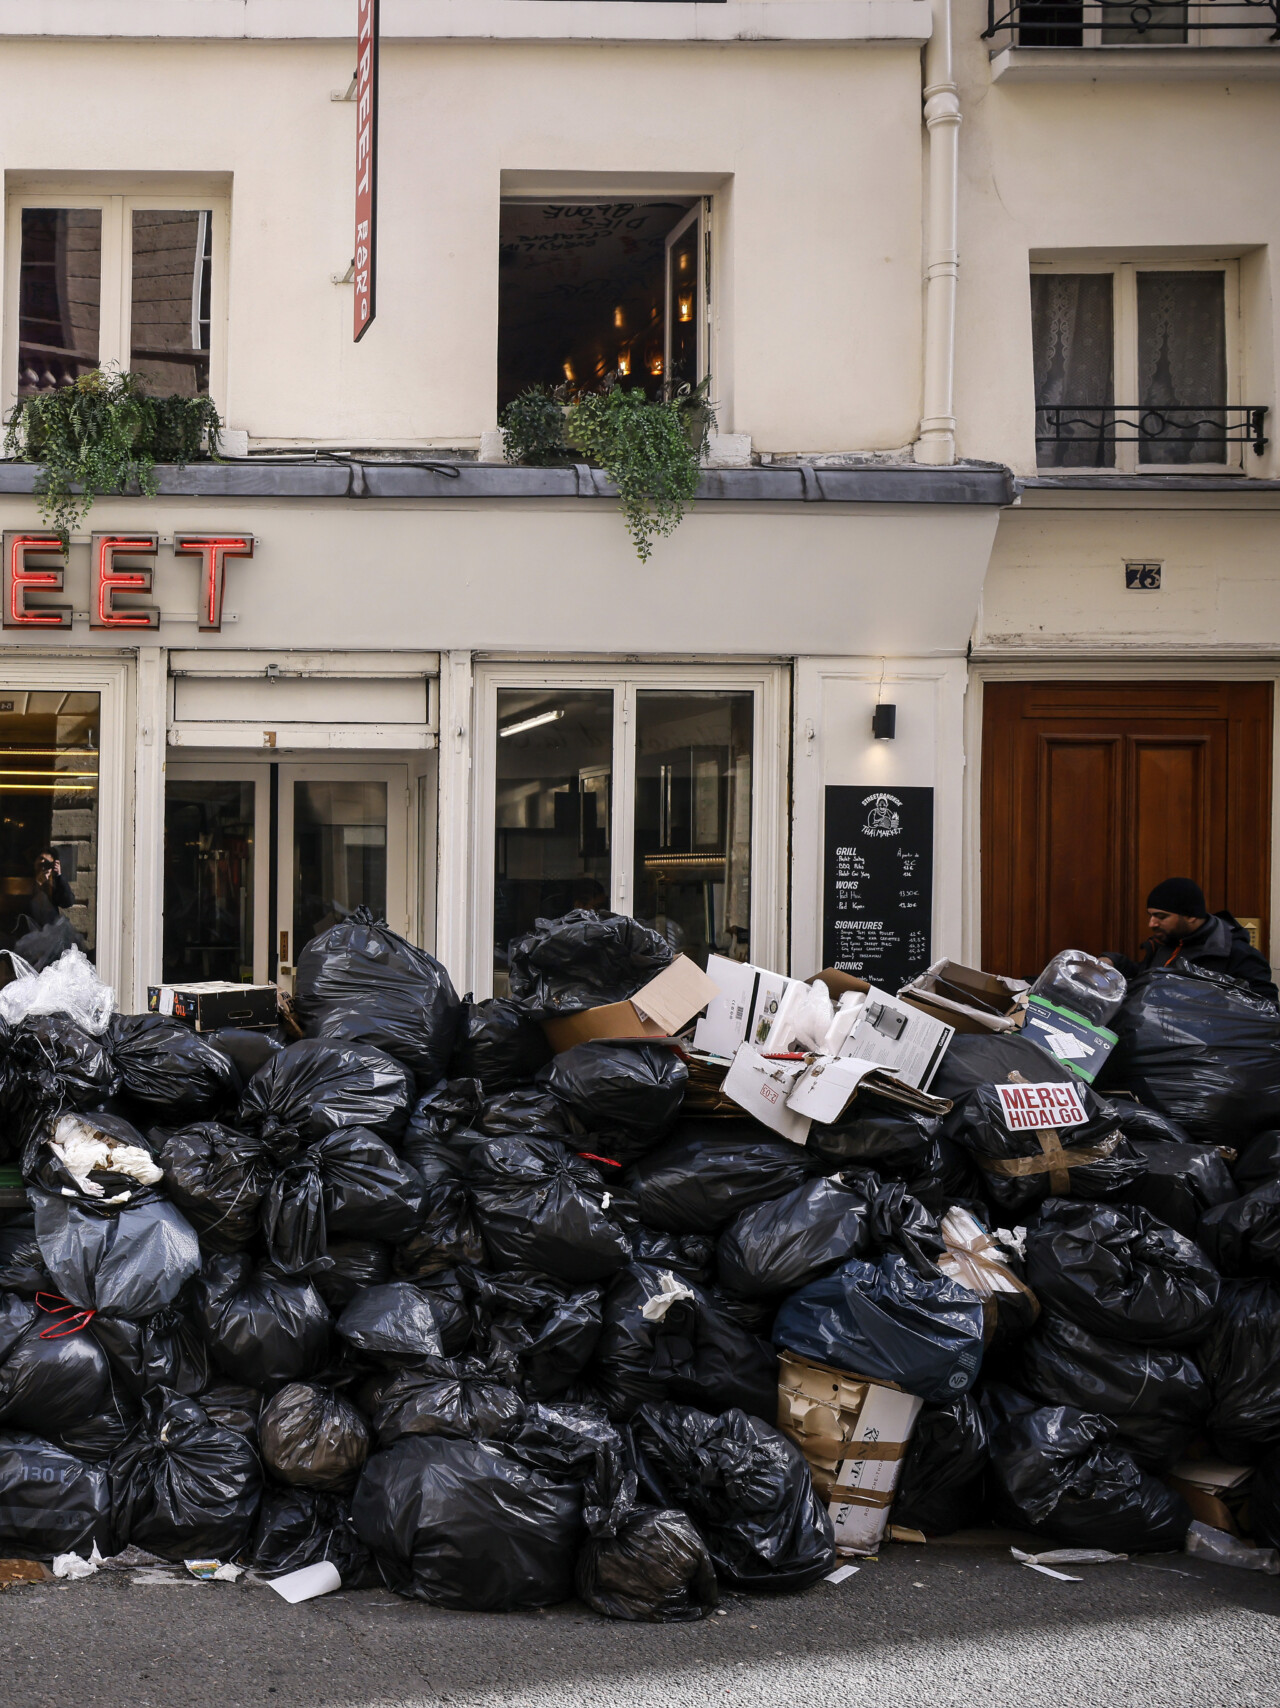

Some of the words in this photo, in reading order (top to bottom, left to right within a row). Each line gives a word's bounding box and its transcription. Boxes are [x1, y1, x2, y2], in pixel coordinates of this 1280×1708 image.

[360, 219, 369, 321] BANG
[1128, 565, 1161, 589] 73
[836, 847, 857, 856] GRILL
[835, 880, 859, 890] WOKS
[834, 920, 884, 930] SIGNATURES
[834, 961, 864, 971] DRINKS
[1001, 1087, 1077, 1110] MERCI
[1008, 1107, 1084, 1128] HIDALGO
[951, 1375, 966, 1386] NF
[20, 1464, 55, 1484] 130
